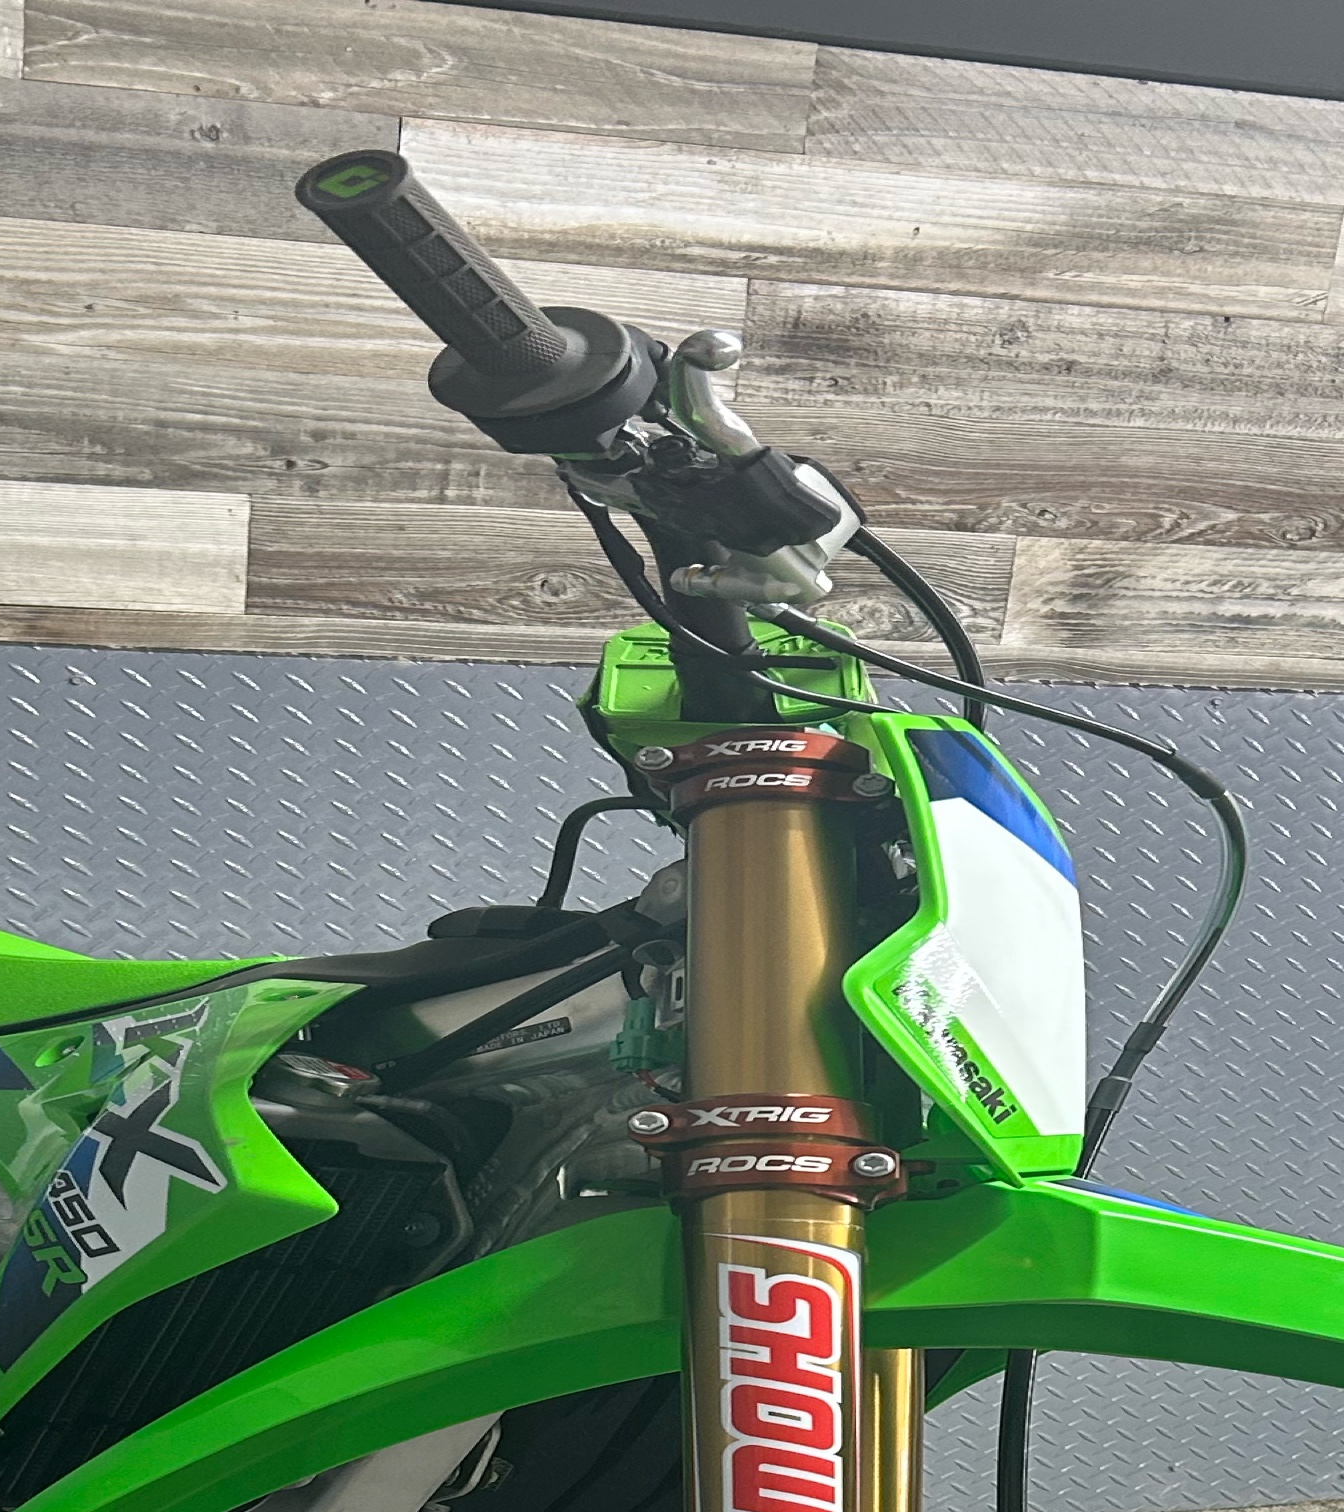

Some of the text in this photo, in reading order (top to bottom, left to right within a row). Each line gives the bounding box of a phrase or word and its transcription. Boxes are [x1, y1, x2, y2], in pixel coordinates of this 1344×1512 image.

[705, 739, 807, 756] XTRIG
[704, 773, 813, 792] ROCS
[511, 1036, 524, 1044] IN
[531, 1026, 565, 1041] JAPAN
[687, 1106, 833, 1127] XTRIG
[687, 1155, 832, 1176] ROCS
[48, 1171, 121, 1258] 450
[23, 1209, 87, 1298] SR
